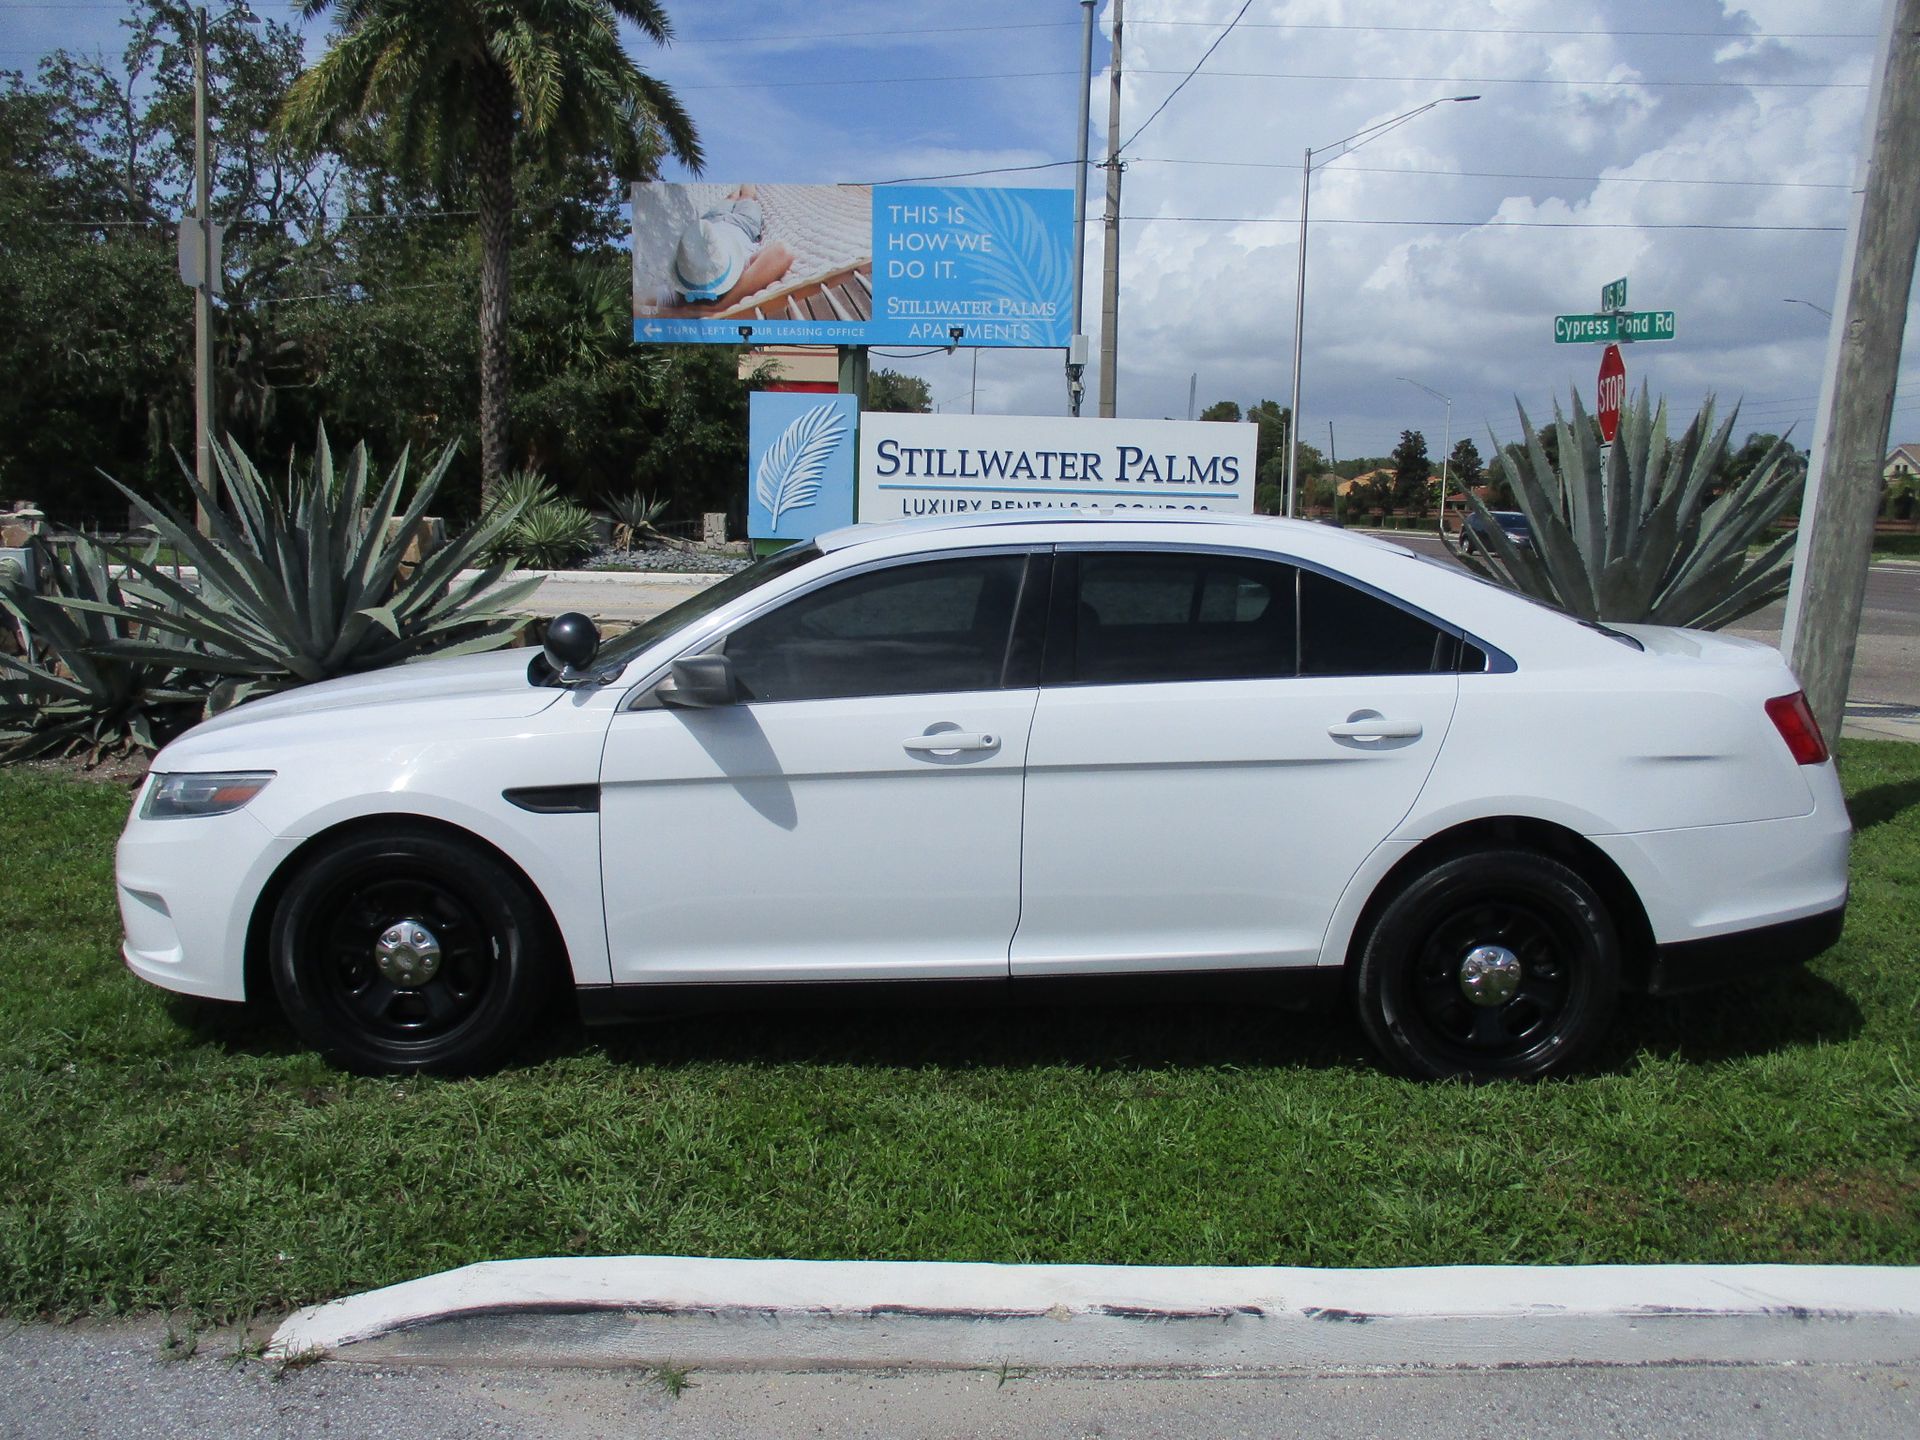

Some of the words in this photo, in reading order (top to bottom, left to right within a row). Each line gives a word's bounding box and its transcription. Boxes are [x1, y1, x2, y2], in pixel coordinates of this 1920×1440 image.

[888, 205, 938, 224] THIS
[948, 206, 965, 224] IS
[888, 233, 949, 251] HOW
[955, 234, 993, 252] WE
[888, 260, 925, 279] DO
[934, 261, 957, 279] IT.
[1603, 286, 1613, 311] US
[667, 326, 697, 336] TURN
[702, 326, 726, 336] LEFT
[776, 327, 823, 337] LEASING
[827, 328, 865, 337] OFFICE
[1555, 317, 1609, 341] Cypress
[1615, 315, 1649, 334] Pond
[1655, 313, 1674, 332] Rd
[1600, 374, 1624, 413] STOP
[903, 498, 982, 516] LUXURY
